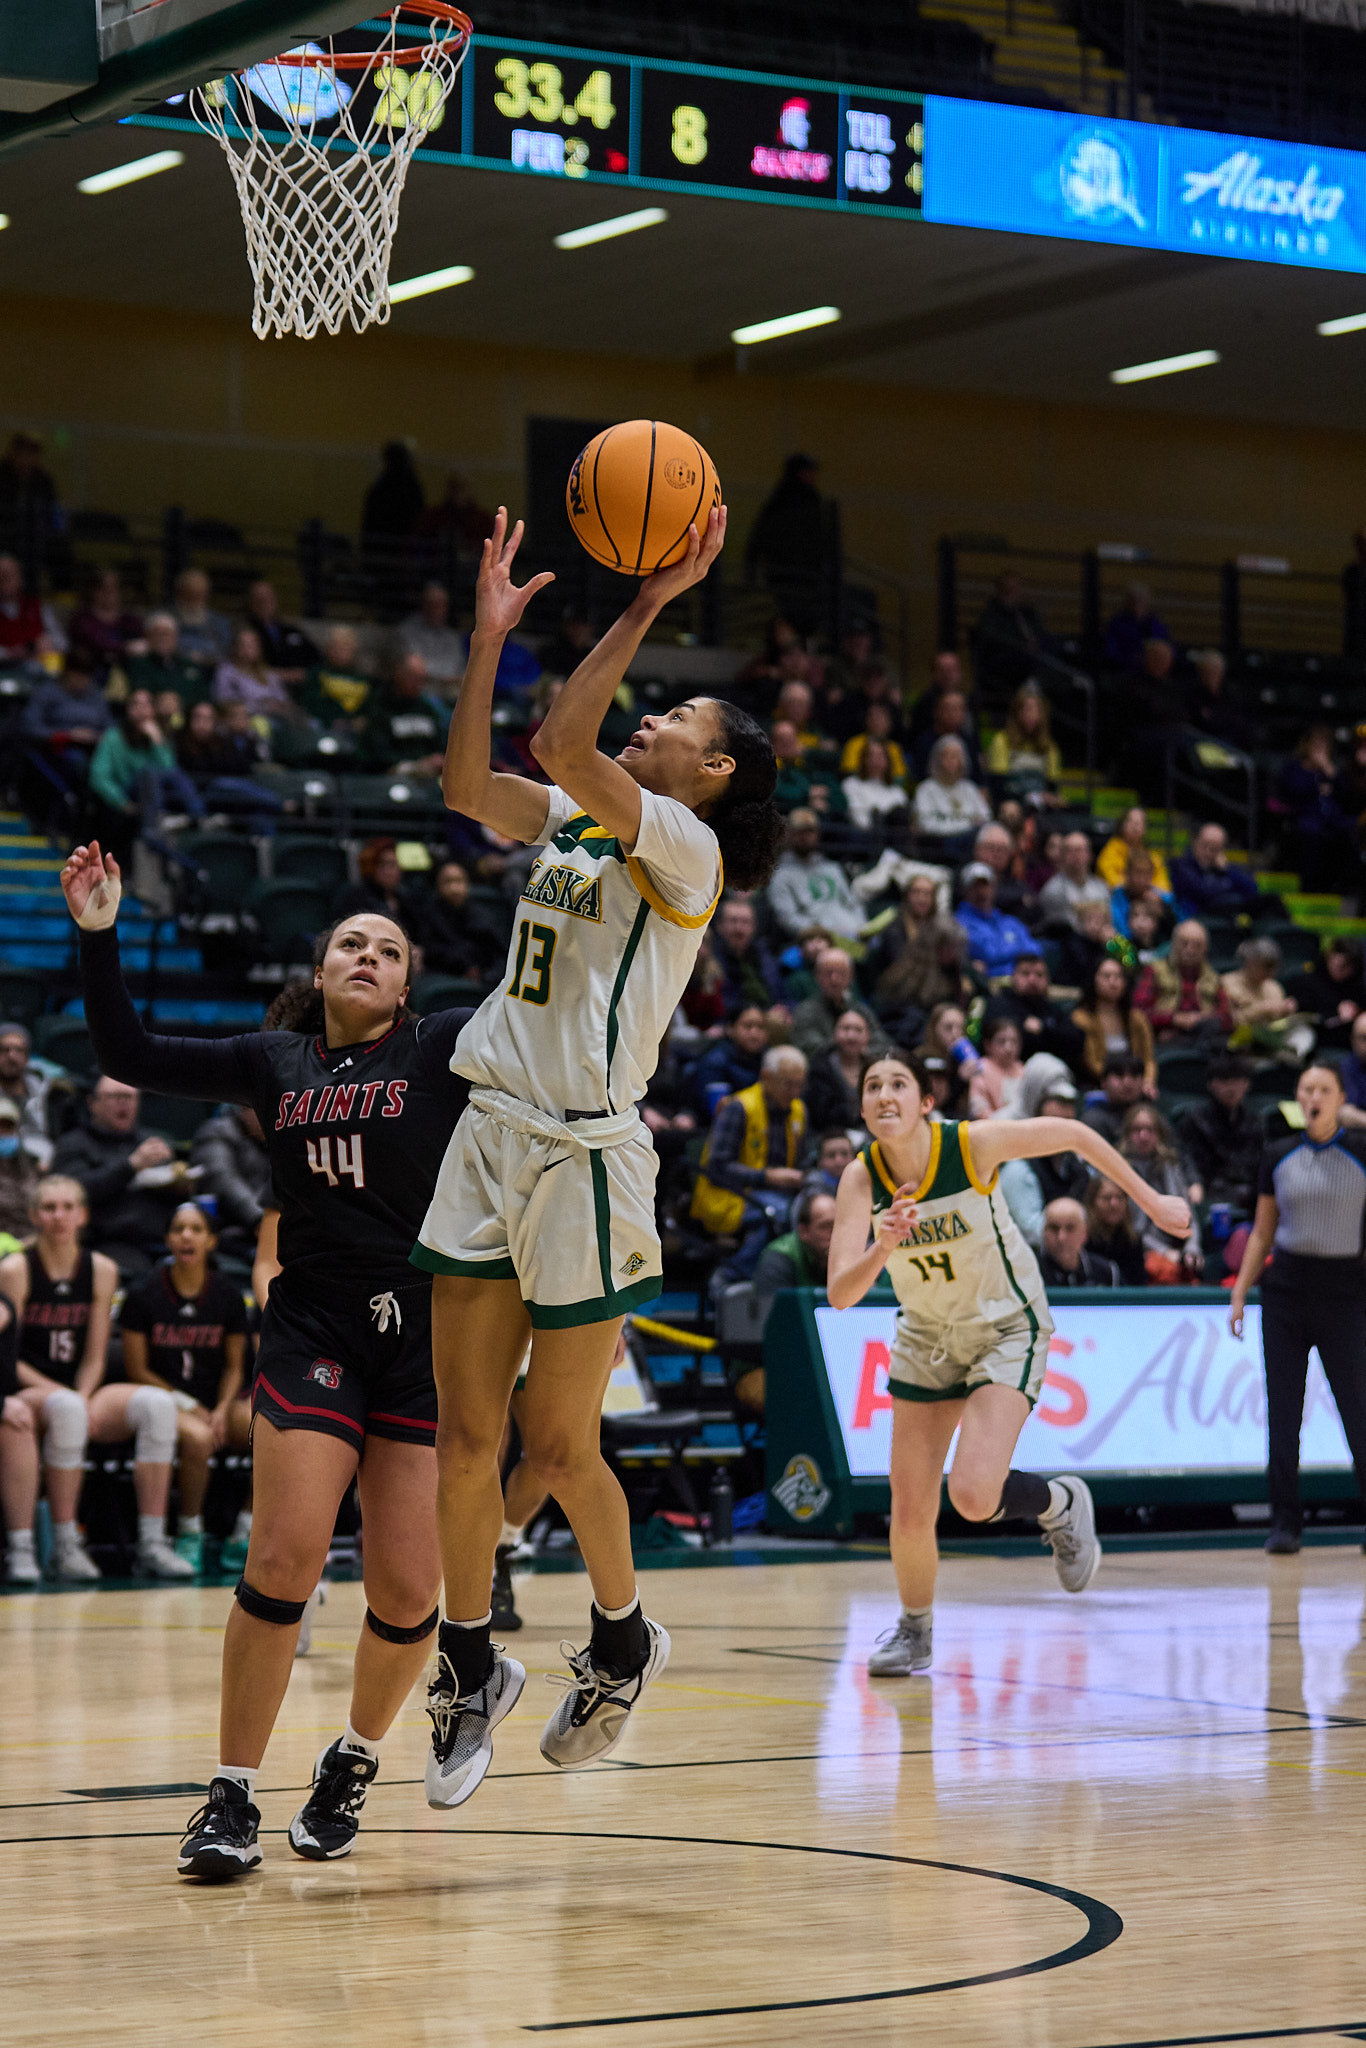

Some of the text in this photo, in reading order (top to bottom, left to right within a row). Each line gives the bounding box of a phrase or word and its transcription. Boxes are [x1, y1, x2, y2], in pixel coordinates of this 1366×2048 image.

[494, 58, 616, 130] 33.4
[564, 136, 590, 179] 2
[671, 105, 708, 165] 8
[1182, 151, 1344, 224] Alaska
[506, 918, 558, 1007] 13
[275, 1080, 408, 1131] SAINTS
[305, 1133, 366, 1189] 44
[908, 1252, 957, 1283] 14
[48, 1330, 75, 1364] 15
[181, 1350, 195, 1380] 1
